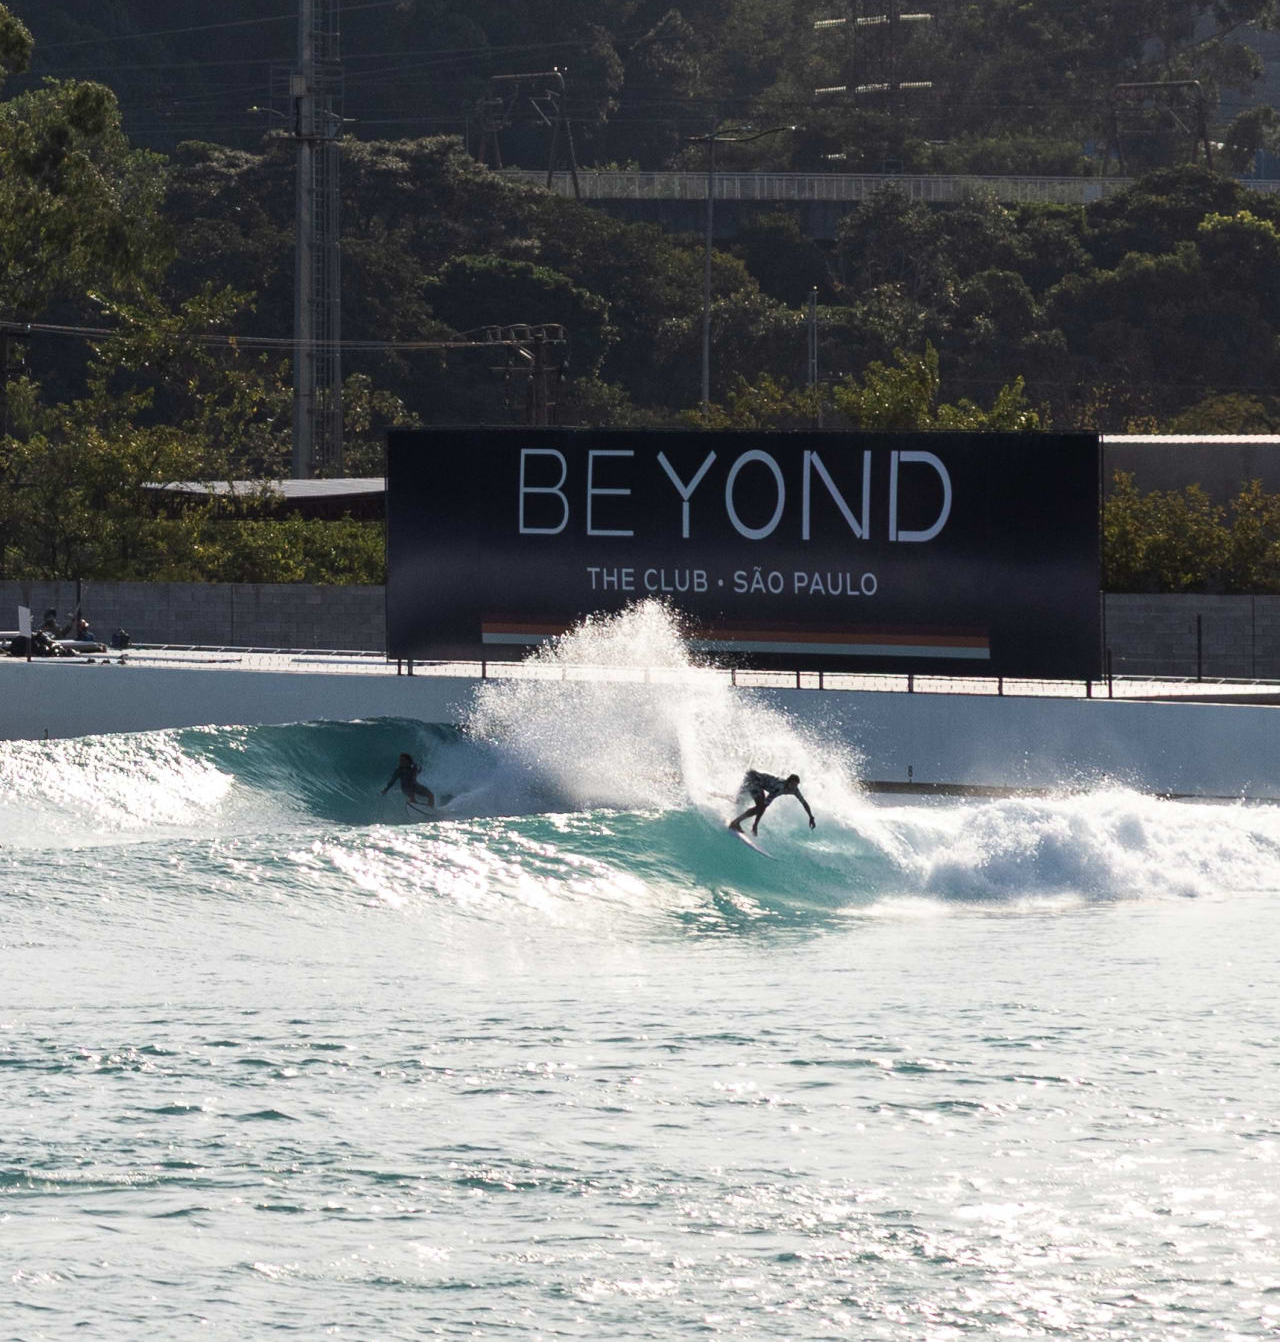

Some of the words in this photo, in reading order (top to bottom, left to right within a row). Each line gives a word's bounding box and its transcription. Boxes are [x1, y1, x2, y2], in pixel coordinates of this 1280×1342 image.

[519, 448, 952, 543] BEYOND
[586, 567, 635, 591] THE
[644, 568, 708, 593] CLUB
[733, 566, 784, 595] SÃO
[794, 571, 878, 596] PAULO
